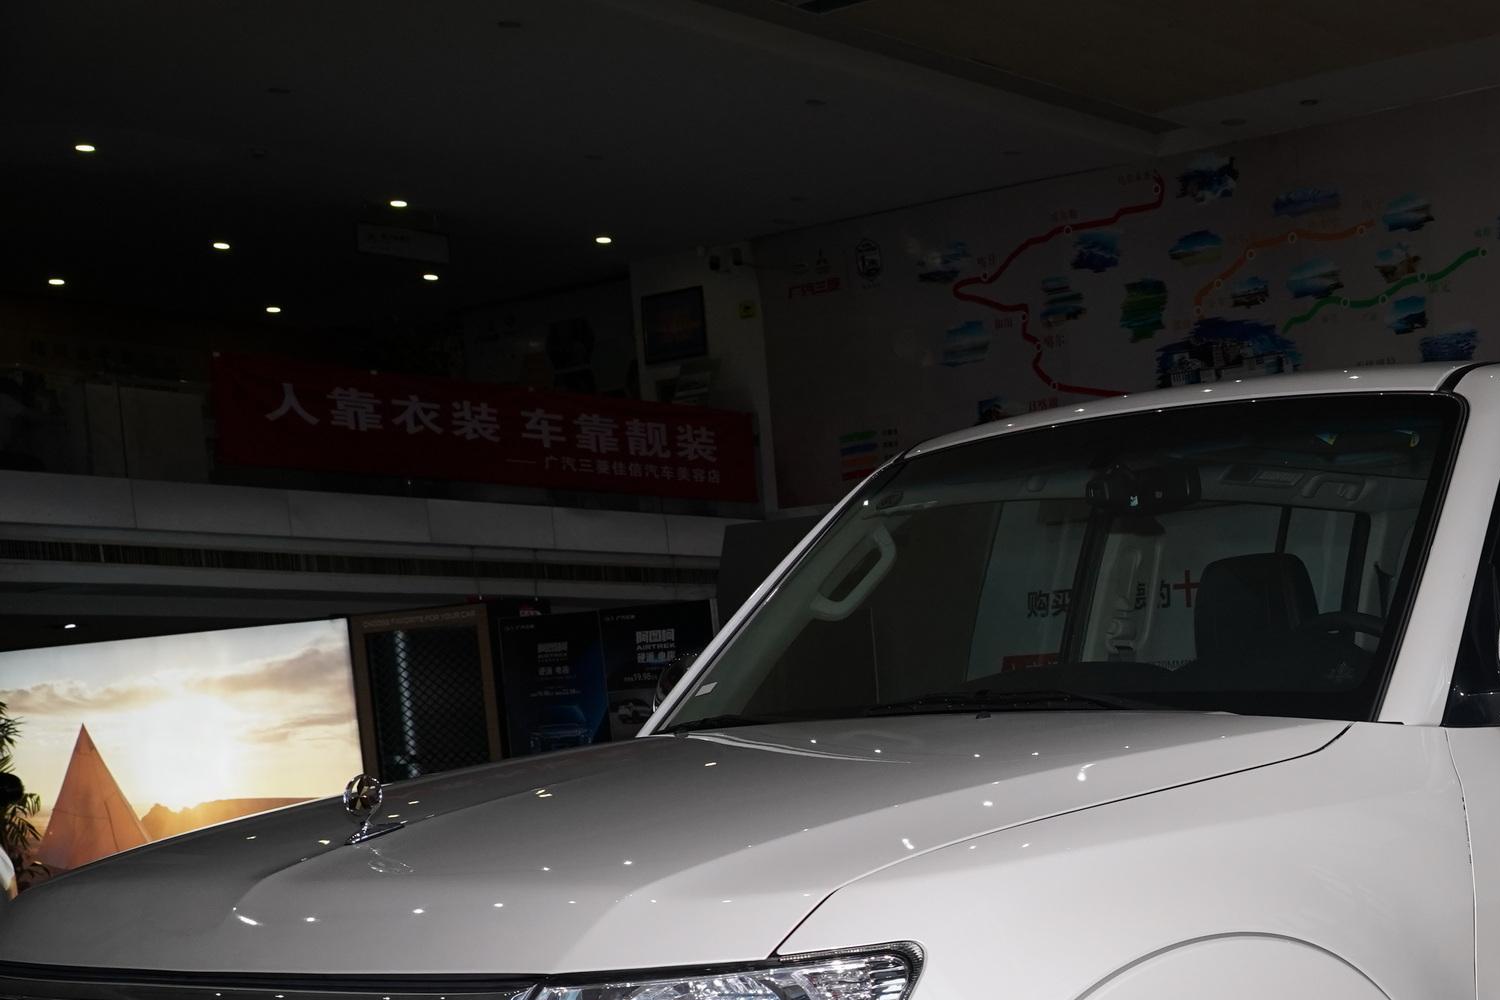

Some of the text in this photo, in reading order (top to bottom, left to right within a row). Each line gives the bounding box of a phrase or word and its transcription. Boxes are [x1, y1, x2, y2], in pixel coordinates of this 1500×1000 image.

[265, 382, 719, 463] 人靠衣装 车靠靓装
